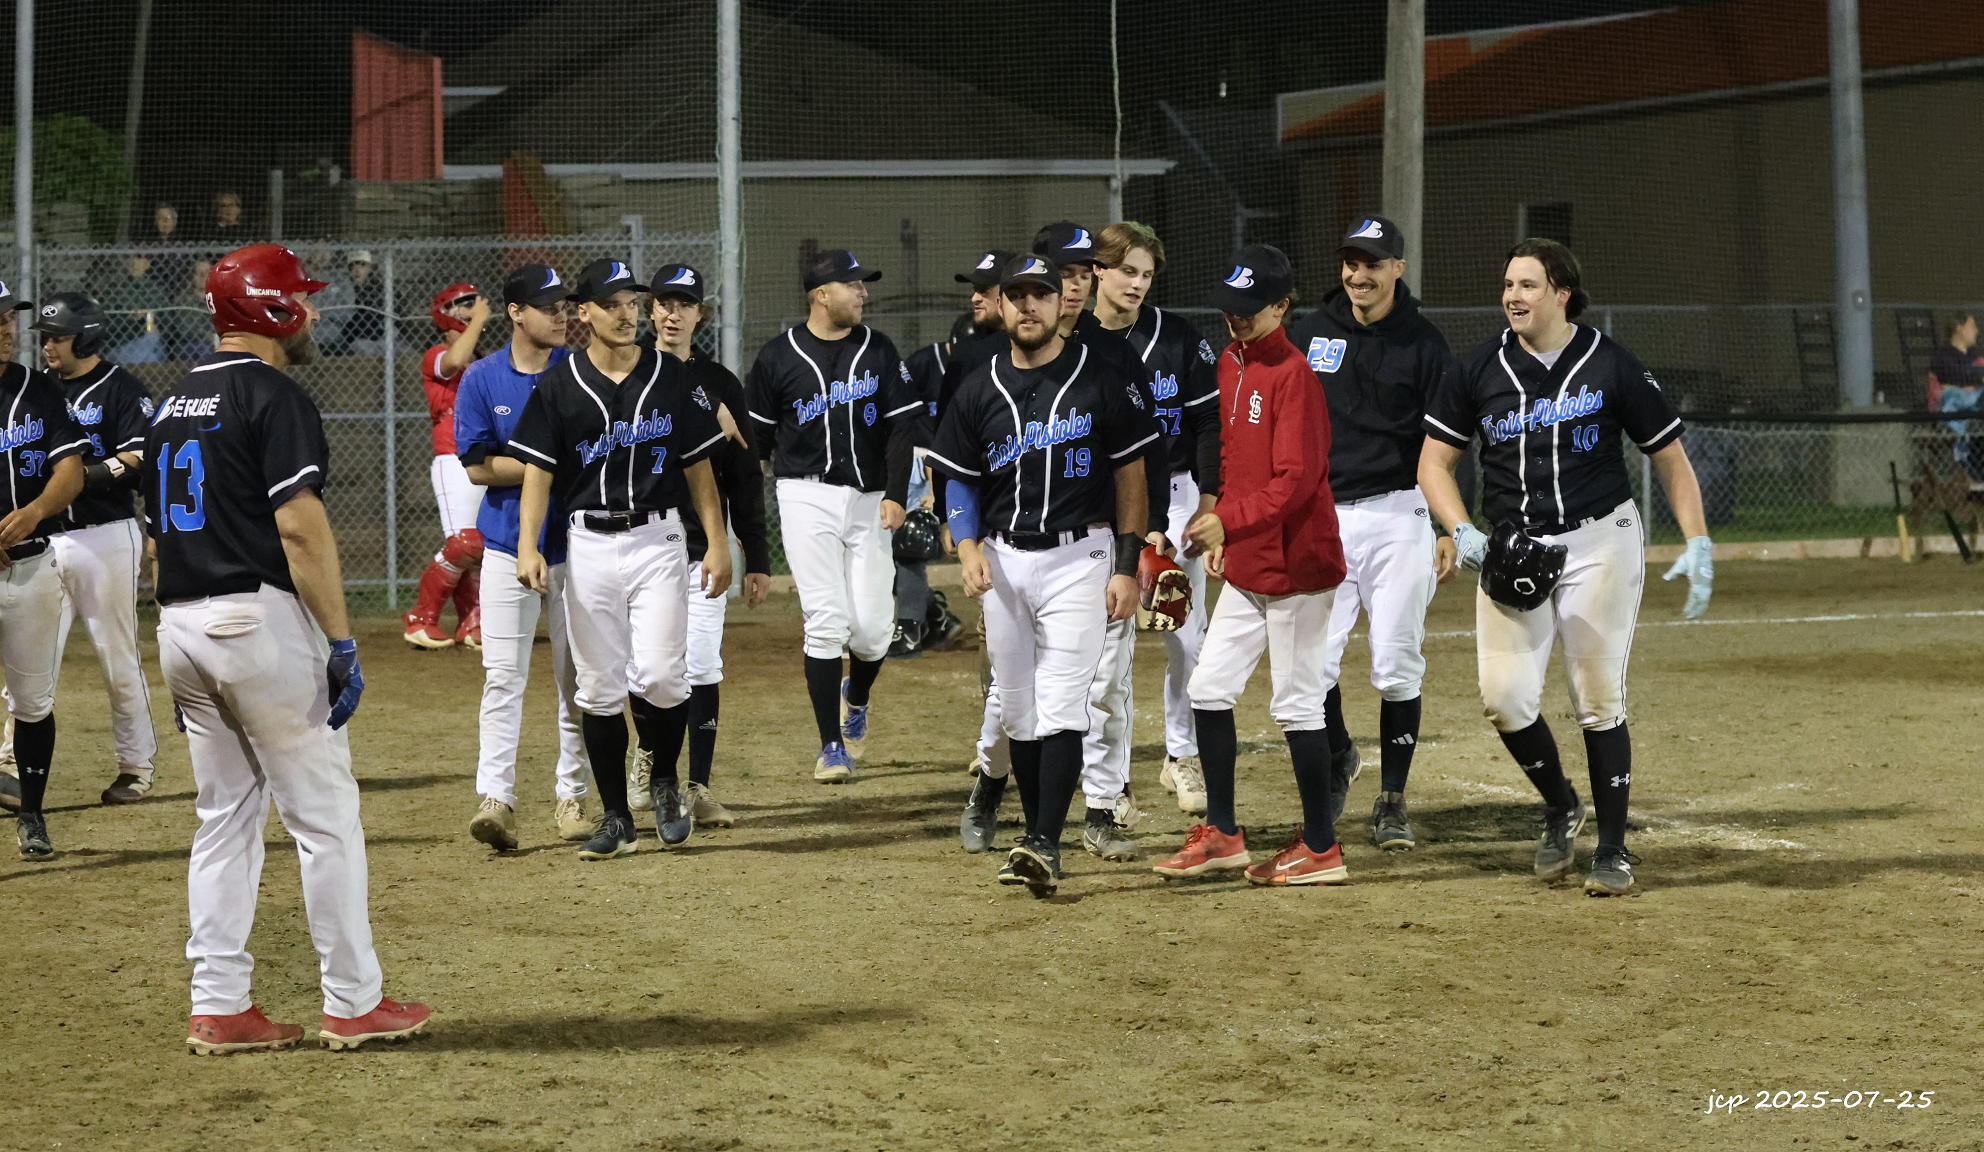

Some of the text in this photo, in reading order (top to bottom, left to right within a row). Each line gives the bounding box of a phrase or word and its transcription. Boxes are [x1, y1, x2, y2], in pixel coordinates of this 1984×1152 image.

[1307, 336, 1347, 373] 29
[151, 394, 220, 427] BÉRUBÉ
[1572, 424, 1600, 452] 10
[19, 450, 47, 477] 37
[651, 447, 667, 473] 7
[1064, 448, 1091, 478] 19
[157, 439, 206, 533] 13
